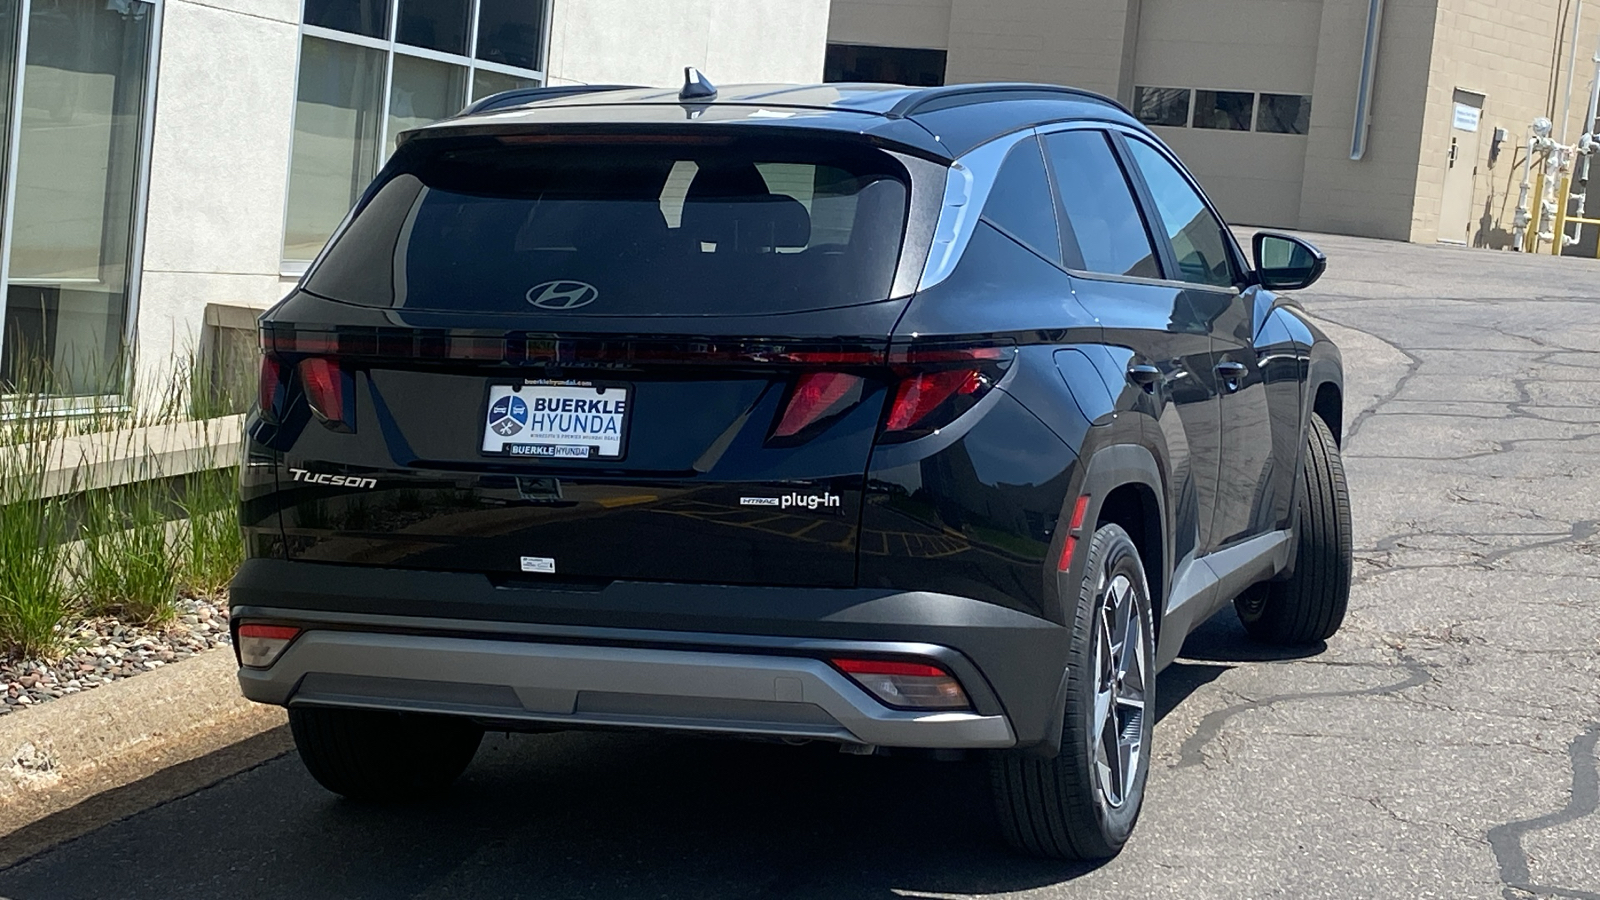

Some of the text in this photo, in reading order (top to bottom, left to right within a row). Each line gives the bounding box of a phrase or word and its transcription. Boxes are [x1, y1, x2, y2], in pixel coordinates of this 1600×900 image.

[525, 378, 592, 386] buerklehyundai.com
[534, 397, 626, 414] BUERKLE
[531, 413, 617, 434] HYUNDA
[512, 445, 588, 456] BUERKLE HYUNDAI
[781, 492, 840, 509] plug-in
